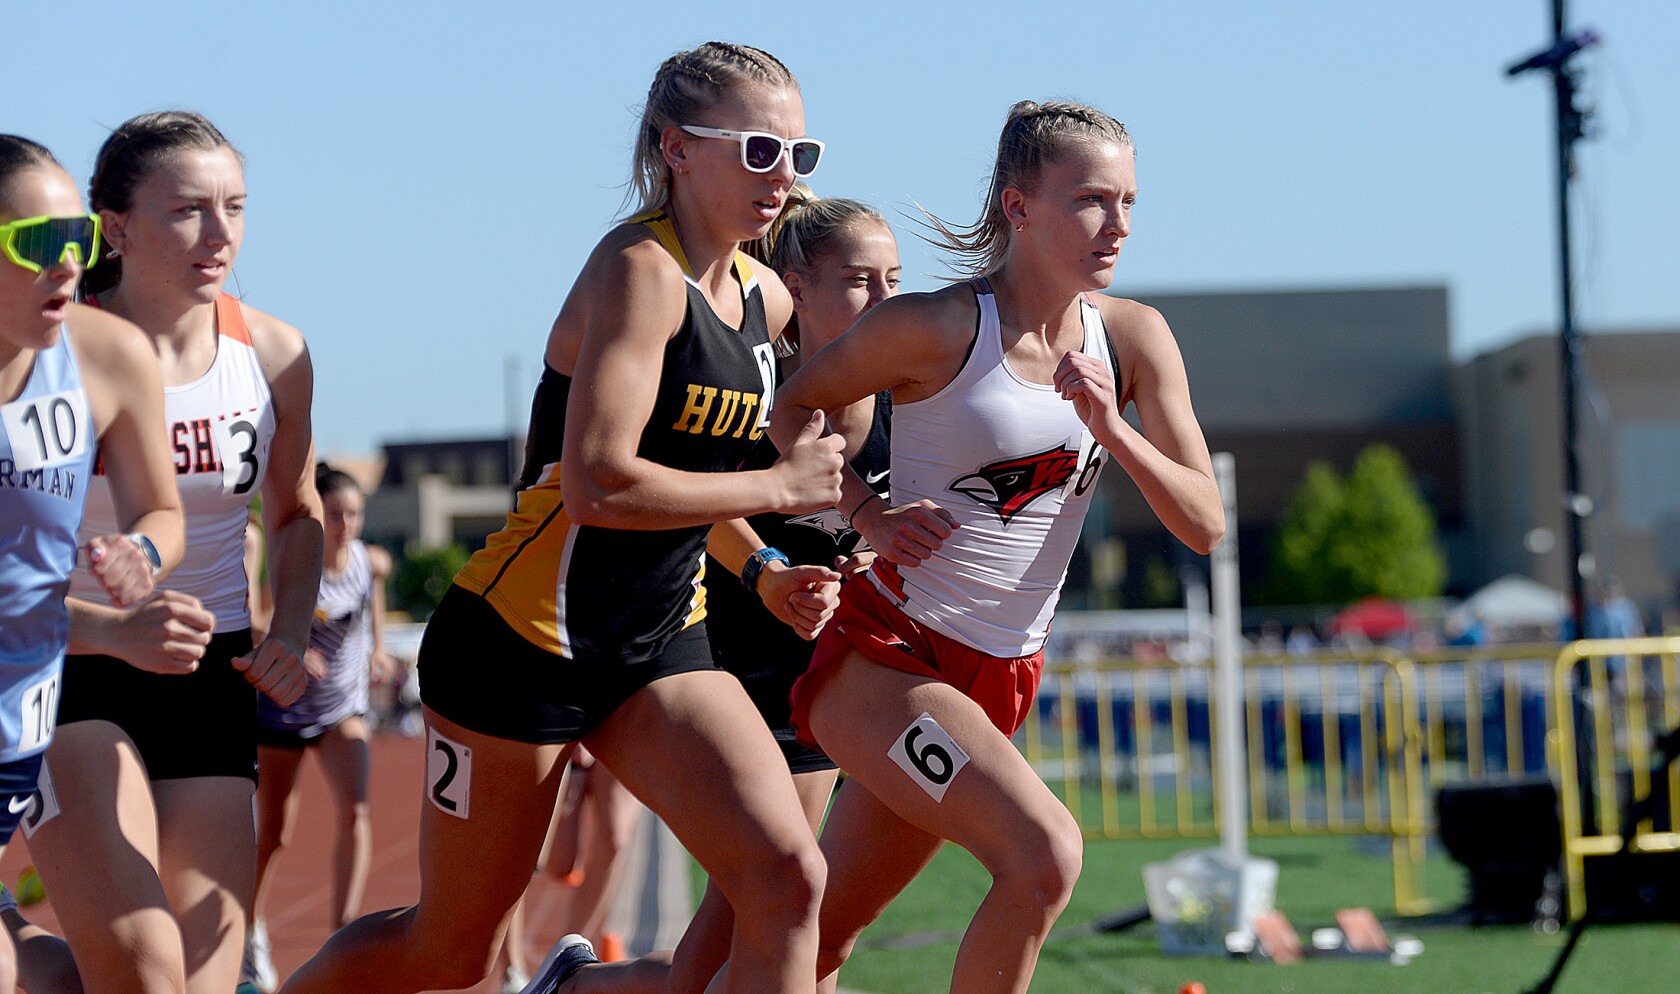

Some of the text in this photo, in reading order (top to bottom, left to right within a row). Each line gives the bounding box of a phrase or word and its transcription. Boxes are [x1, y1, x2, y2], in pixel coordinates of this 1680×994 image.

[20, 397, 76, 461] 10
[227, 420, 258, 494] 3
[1075, 441, 1102, 497] 6
[31, 680, 56, 744] 10
[432, 740, 458, 812] 2
[904, 725, 954, 785] 6
